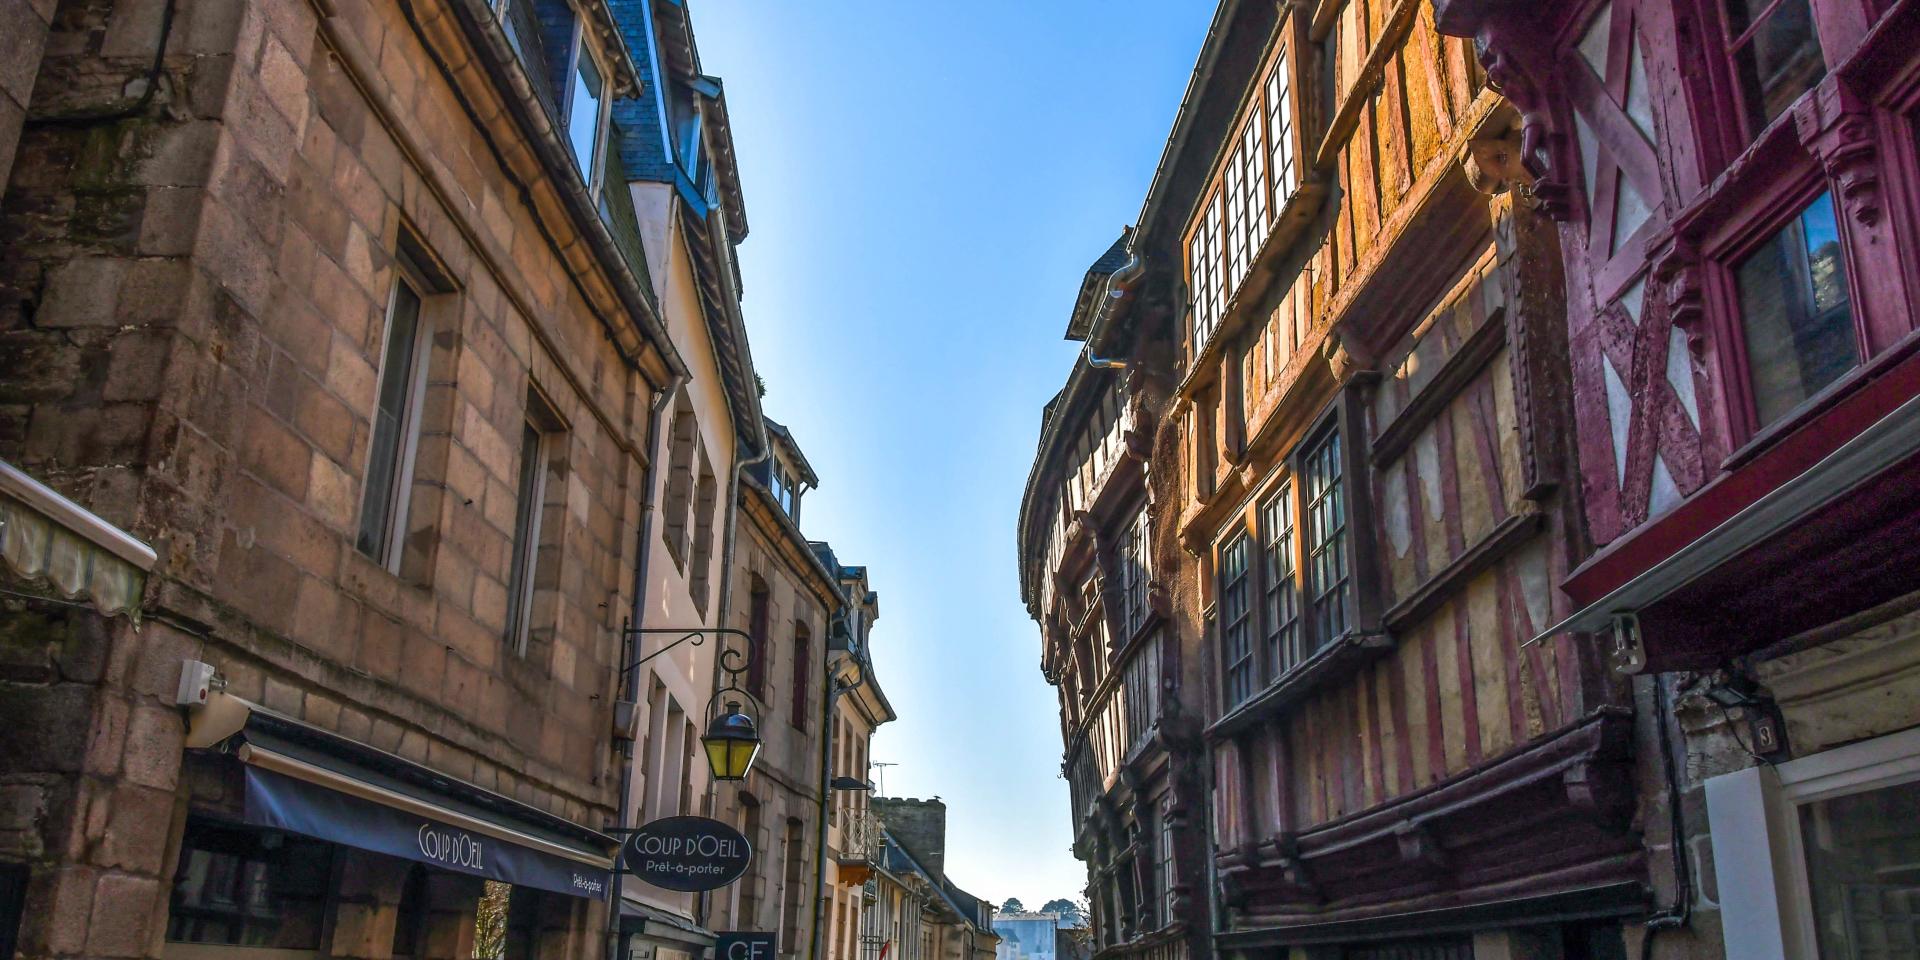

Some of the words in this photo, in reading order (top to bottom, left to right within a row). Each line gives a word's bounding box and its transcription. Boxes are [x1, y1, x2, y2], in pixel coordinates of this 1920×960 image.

[418, 823, 451, 862] COUP
[452, 832, 483, 870] D'OEIL
[635, 832, 681, 856] COUP
[685, 833, 741, 858] D'OEIL
[646, 860, 725, 877] Prêt-à-porter
